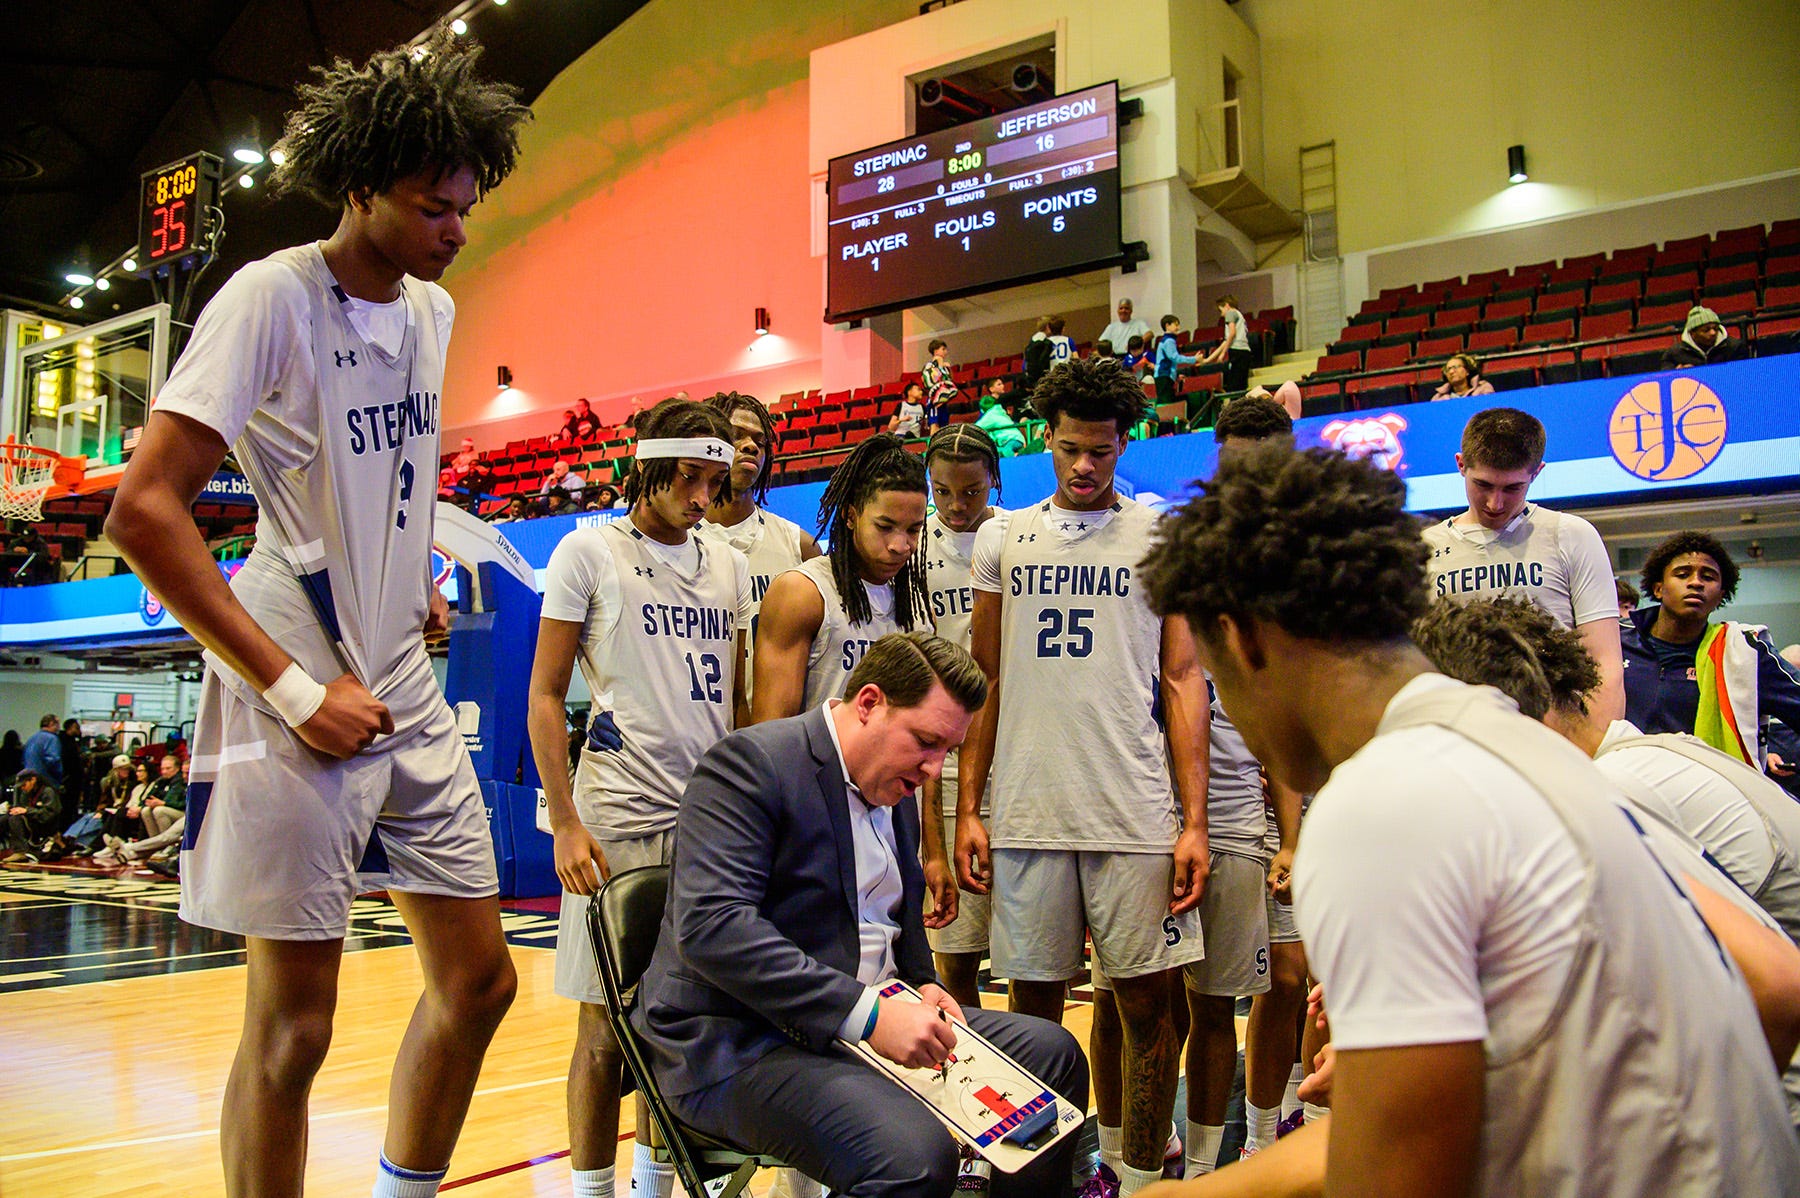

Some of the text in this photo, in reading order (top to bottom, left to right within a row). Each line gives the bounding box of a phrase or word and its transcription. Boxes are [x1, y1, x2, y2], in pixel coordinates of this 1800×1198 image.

[998, 98, 1096, 138] JEFFERSON
[1035, 134, 1054, 151] 16
[854, 144, 927, 177] STEPINAC
[948, 152, 982, 174] 8:00
[1035, 173, 1043, 185] 3
[1086, 160, 1094, 172] 2
[157, 166, 196, 204] 8:00
[877, 176, 895, 193] 28
[937, 172, 992, 195] 0 FOULS 0
[945, 189, 986, 207] TIMEOUTS
[151, 201, 185, 257] 35
[842, 187, 1097, 260] PLAYER FOULS POINTS
[872, 213, 879, 225] 2
[918, 202, 925, 214] 3
[871, 215, 1065, 271] 1 1 5
[1010, 564, 1131, 598] STEPINAC
[1436, 561, 1544, 597] STEPINAC
[642, 602, 734, 642] STEPINAC
[1036, 606, 1095, 660] 25
[685, 651, 723, 704] 12
[1161, 914, 1182, 948] S
[1255, 946, 1268, 976] S
[984, 1096, 1048, 1142] STEPINAC
